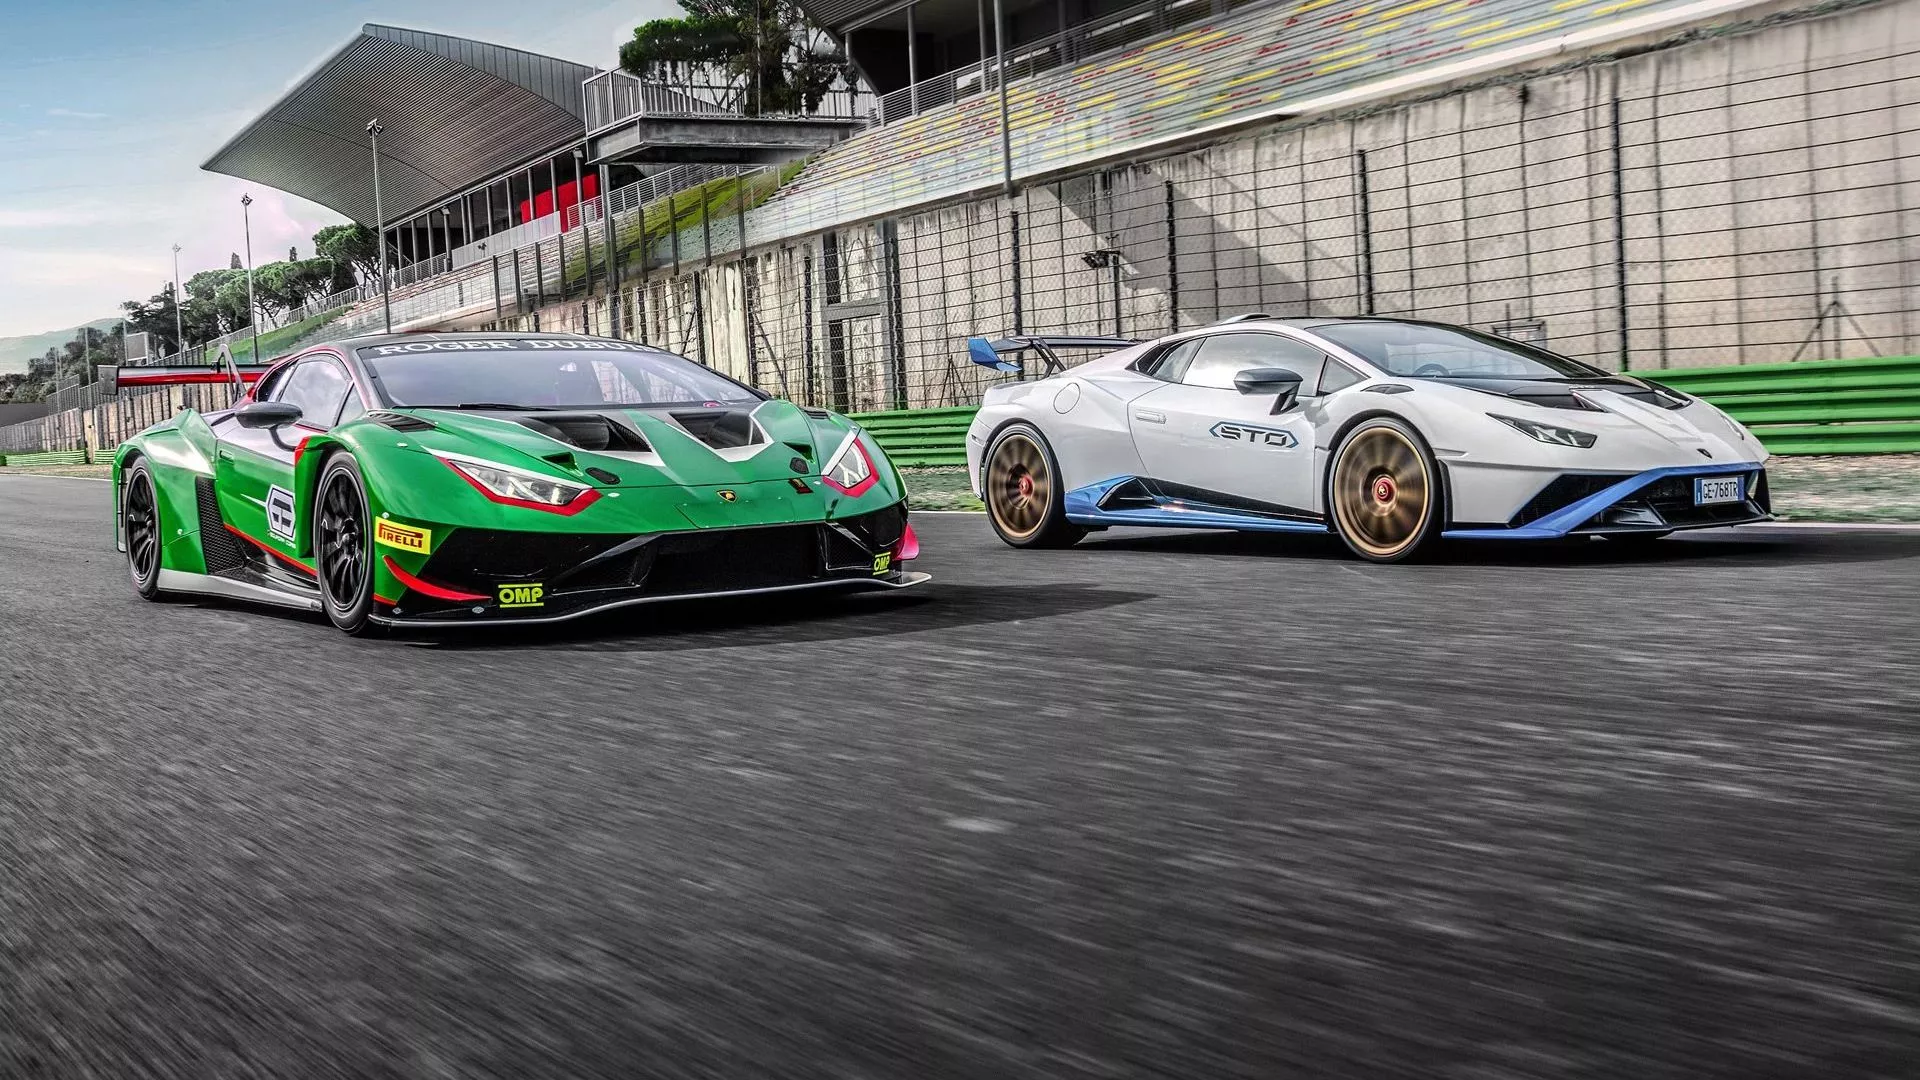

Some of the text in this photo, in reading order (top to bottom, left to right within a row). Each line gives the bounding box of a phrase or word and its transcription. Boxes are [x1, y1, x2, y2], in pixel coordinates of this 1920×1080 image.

[374, 340, 518, 355] ROGER
[1220, 425, 1288, 447] STO
[378, 522, 424, 549] PIRELLI
[873, 555, 890, 571] OMP
[498, 587, 544, 604] OMP
